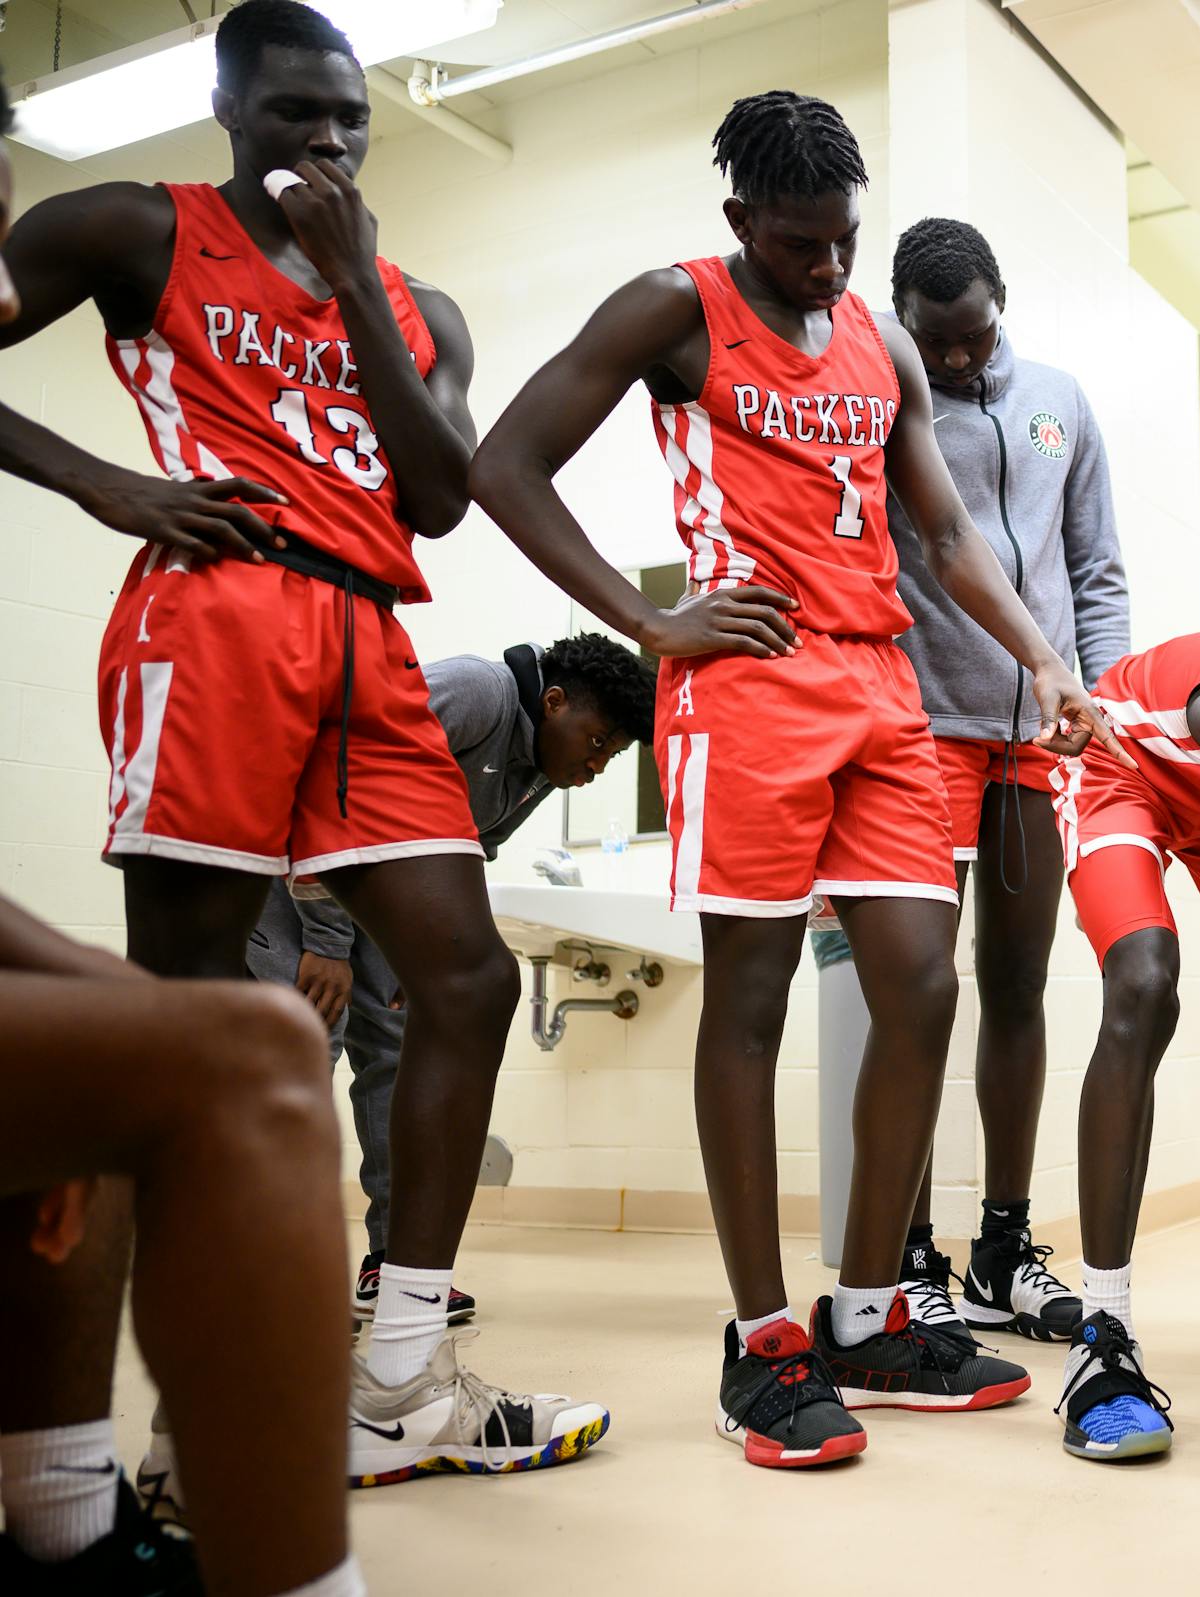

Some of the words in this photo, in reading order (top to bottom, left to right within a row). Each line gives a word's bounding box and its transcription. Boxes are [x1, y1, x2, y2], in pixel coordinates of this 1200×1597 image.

[203, 303, 362, 397] PACKE
[271, 387, 389, 492] 13
[828, 455, 866, 540] 1
[674, 669, 695, 717] A
